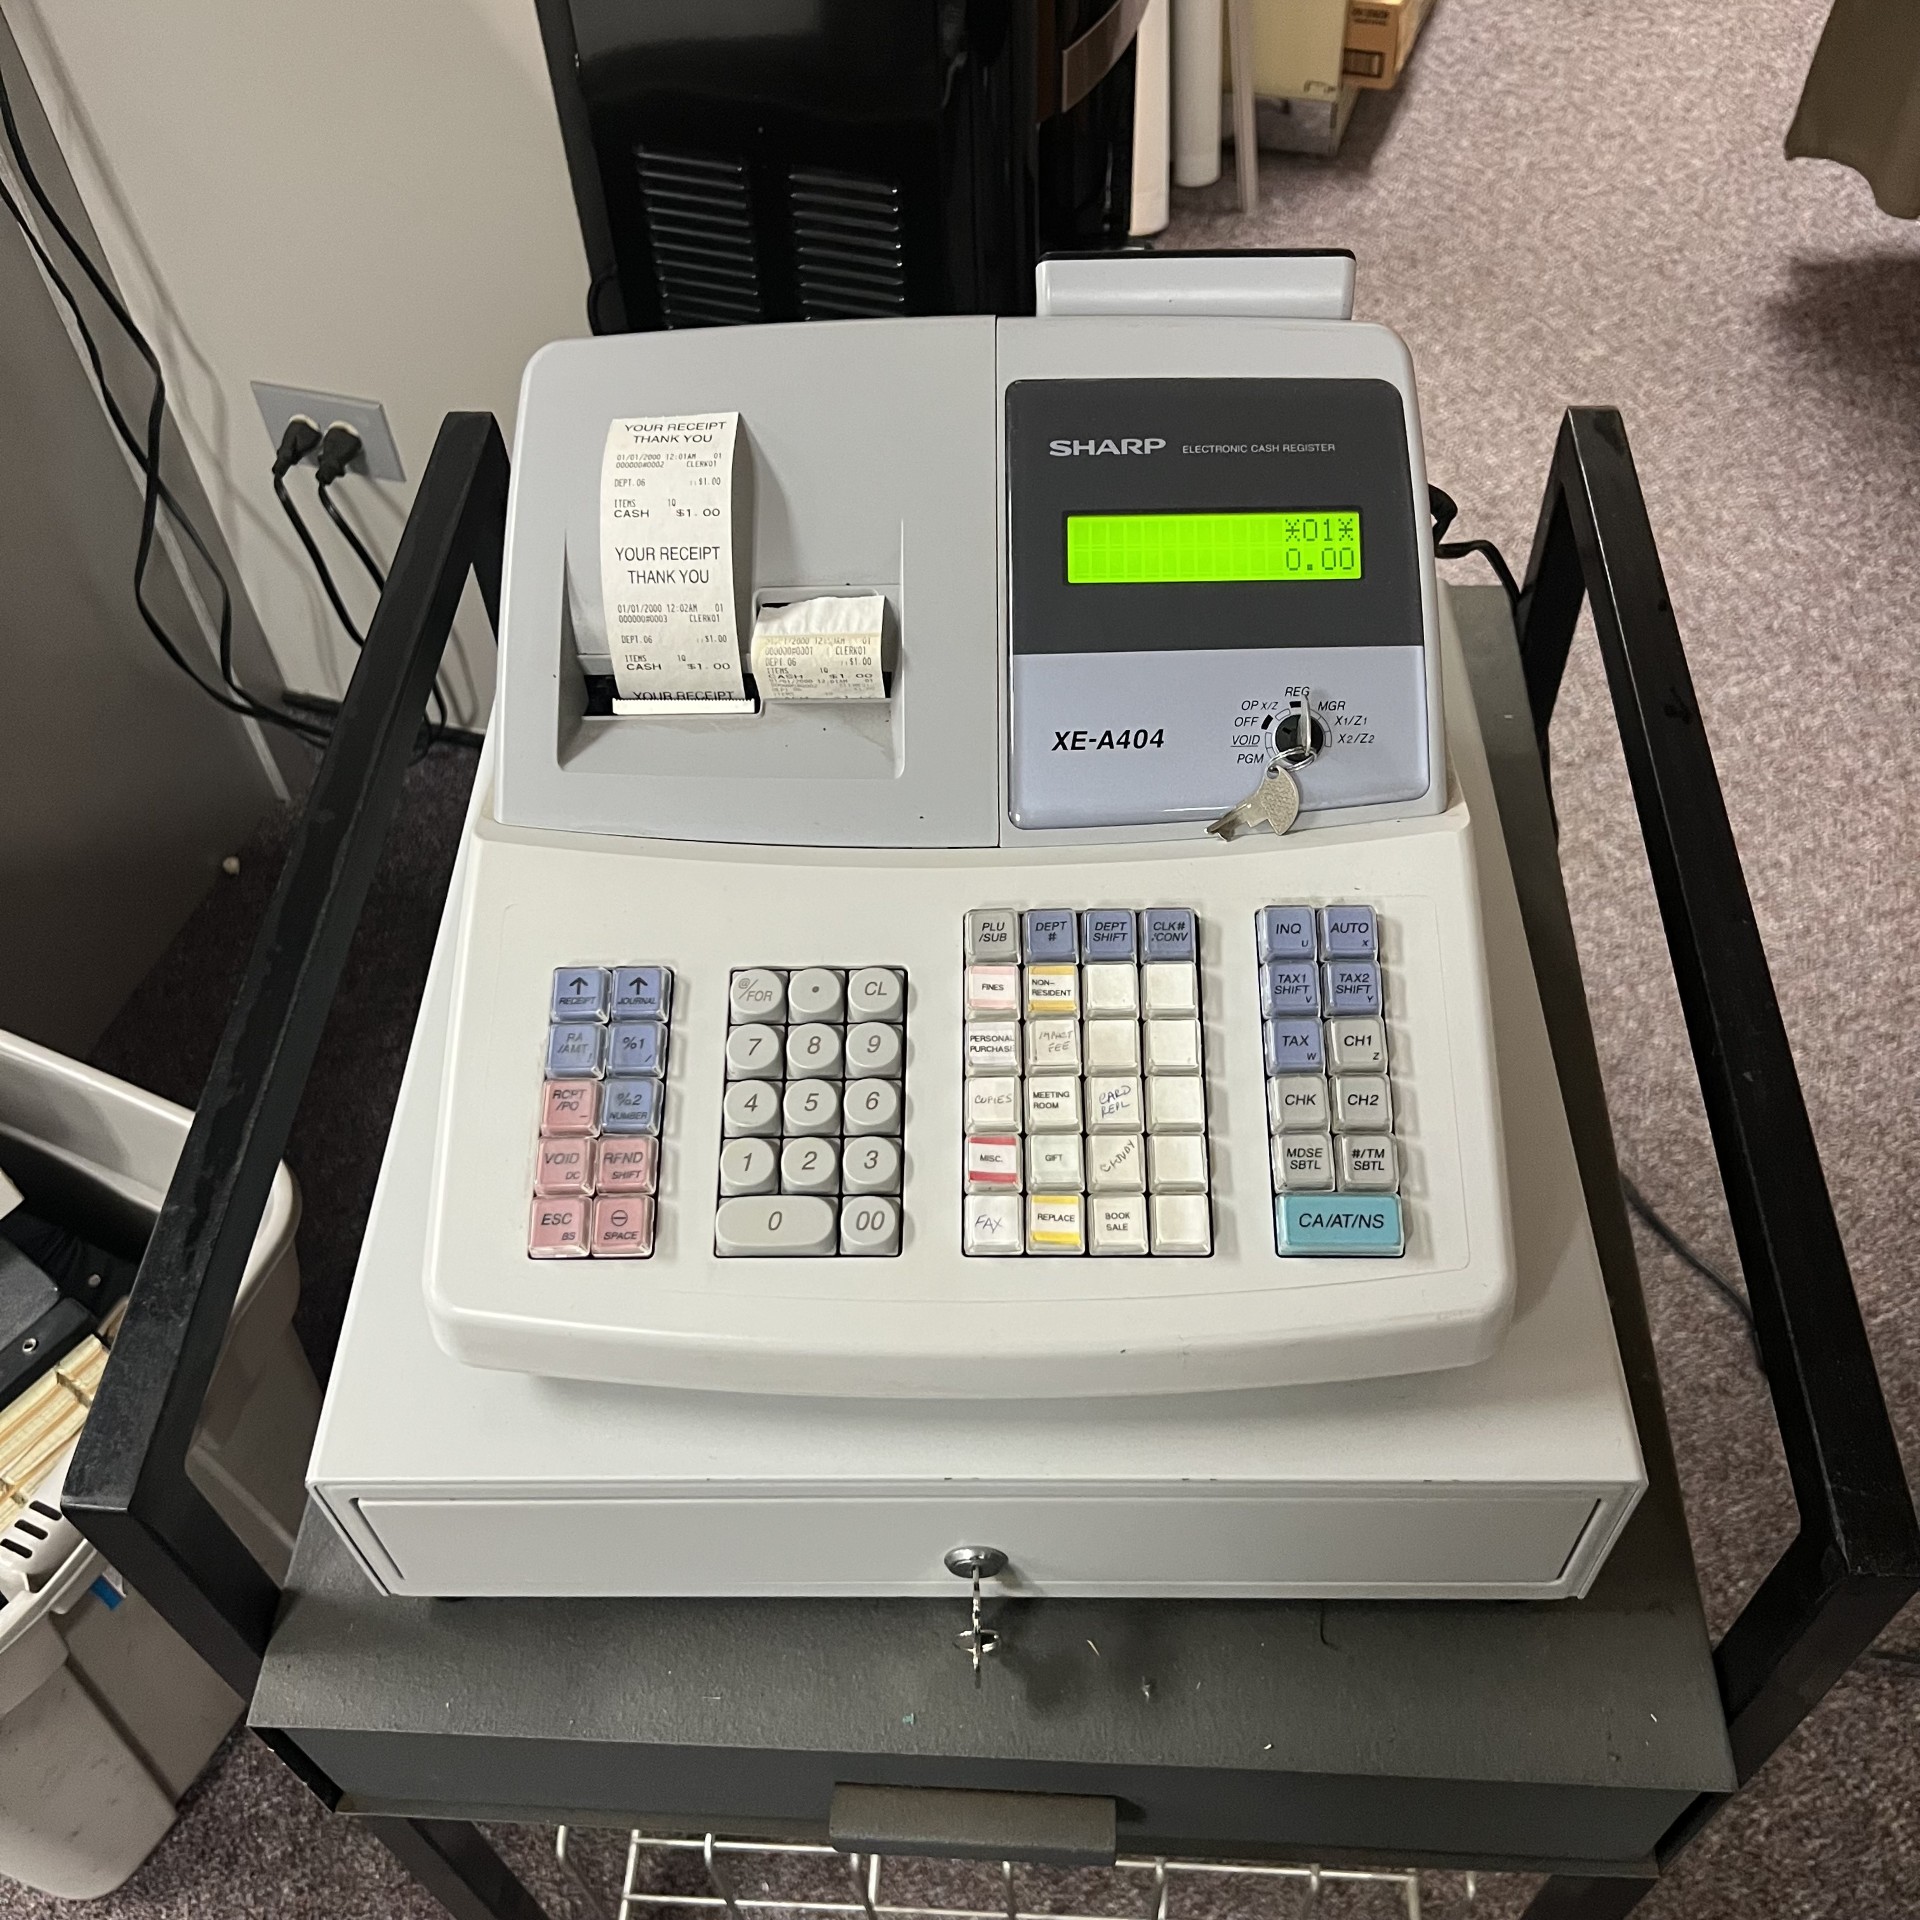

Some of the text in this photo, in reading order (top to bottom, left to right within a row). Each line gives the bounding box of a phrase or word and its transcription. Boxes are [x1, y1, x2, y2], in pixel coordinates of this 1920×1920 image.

[625, 421, 727, 432] YOUR RECEIPT
[633, 434, 713, 443] THANK YOU
[1049, 438, 1167, 457] SHARP
[1182, 443, 1336, 454] ELECTRONIC CASH REGISTER
[713, 452, 723, 460] 01
[686, 460, 717, 468] CLERK01
[613, 478, 646, 488] DEPT.06
[613, 498, 636, 508] ITEMS
[613, 508, 721, 518] CASH $1.00
[614, 546, 721, 561] YOUR RECEIPT
[1286, 547, 1354, 571] 0.00
[627, 569, 710, 584] THANK YOU
[617, 603, 724, 613] 01/01/2000 12:02AM 01
[689, 613, 720, 623] CLERK01
[621, 635, 653, 644] DEPT.06
[835, 645, 867, 656] CLERK01
[624, 654, 647, 662] ITEMS
[626, 663, 662, 671] CASH
[1284, 686, 1311, 697] REG
[1241, 700, 1279, 711] OP X/Z
[1317, 700, 1346, 711] MGR
[1234, 717, 1259, 728] OFF
[1334, 715, 1368, 726] X1/Z1
[1051, 729, 1165, 752] XE-A404
[1232, 735, 1261, 746] VOID
[1337, 733, 1375, 745] X2/Z2
[1236, 754, 1264, 764] PGM
[981, 922, 1005, 931] PLU
[1035, 921, 1067, 931] DEPT
[1094, 922, 1127, 931] DEPT
[1153, 922, 1186, 931] CLK#
[1276, 923, 1302, 934] INQ
[1330, 923, 1369, 933] AUTO
[979, 933, 1008, 942] /SUB
[1048, 932, 1057, 942] #
[1093, 932, 1128, 942] SHIFT
[1362, 939, 1369, 947] X
[1278, 974, 1307, 983] TAX1
[1339, 973, 1370, 983] TAX2
[864, 982, 888, 997] CL
[981, 983, 1005, 991] FINES
[1274, 985, 1310, 995] SHIFT
[1335, 984, 1372, 994] SHIFT
[1031, 989, 1072, 997] RESIDENT
[1367, 995, 1374, 1003] Y
[623, 1037, 645, 1050] %1
[807, 1036, 821, 1055] 8
[867, 1035, 881, 1053] 9
[1283, 1036, 1310, 1047] TAX
[1344, 1035, 1372, 1047] CH1
[748, 1038, 761, 1056] 7
[1048, 1041, 1071, 1053] FEE
[553, 1089, 587, 1099] RCPT
[1033, 1091, 1070, 1099] MEETING
[1099, 1085, 1131, 1105] CARD
[617, 1094, 642, 1106] %2
[744, 1094, 758, 1112] 4
[804, 1093, 819, 1111] 5
[866, 1092, 880, 1110] 6
[1285, 1094, 1316, 1105] CHK
[1347, 1094, 1379, 1105] CH2
[556, 1101, 579, 1111] /PO
[1033, 1101, 1059, 1109] ROOM
[609, 1111, 648, 1120] NUMBER
[604, 1152, 643, 1163] RFND
[1045, 1153, 1063, 1162] GIFT
[1286, 1148, 1323, 1157] MDSE
[1352, 1149, 1384, 1158] #/TM
[545, 1153, 579, 1164] VOID
[743, 1153, 753, 1172] 1
[802, 1151, 817, 1170] 2
[864, 1151, 879, 1169] 3
[980, 1154, 1003, 1163] MISC.
[1290, 1160, 1321, 1169] SBTL
[1353, 1161, 1384, 1170] SBTL
[565, 1171, 581, 1180] DC
[612, 1170, 641, 1180] SHIFT
[541, 1213, 572, 1226] ESC
[768, 1211, 782, 1230] 0
[855, 1210, 885, 1230] 00
[1037, 1213, 1075, 1222] REPLACE
[1105, 1212, 1130, 1220] BOOK
[1299, 1213, 1385, 1229] CA/AT/NS
[975, 1214, 1003, 1233] FAX
[561, 1232, 576, 1241] BS
[604, 1231, 639, 1240] SPACE
